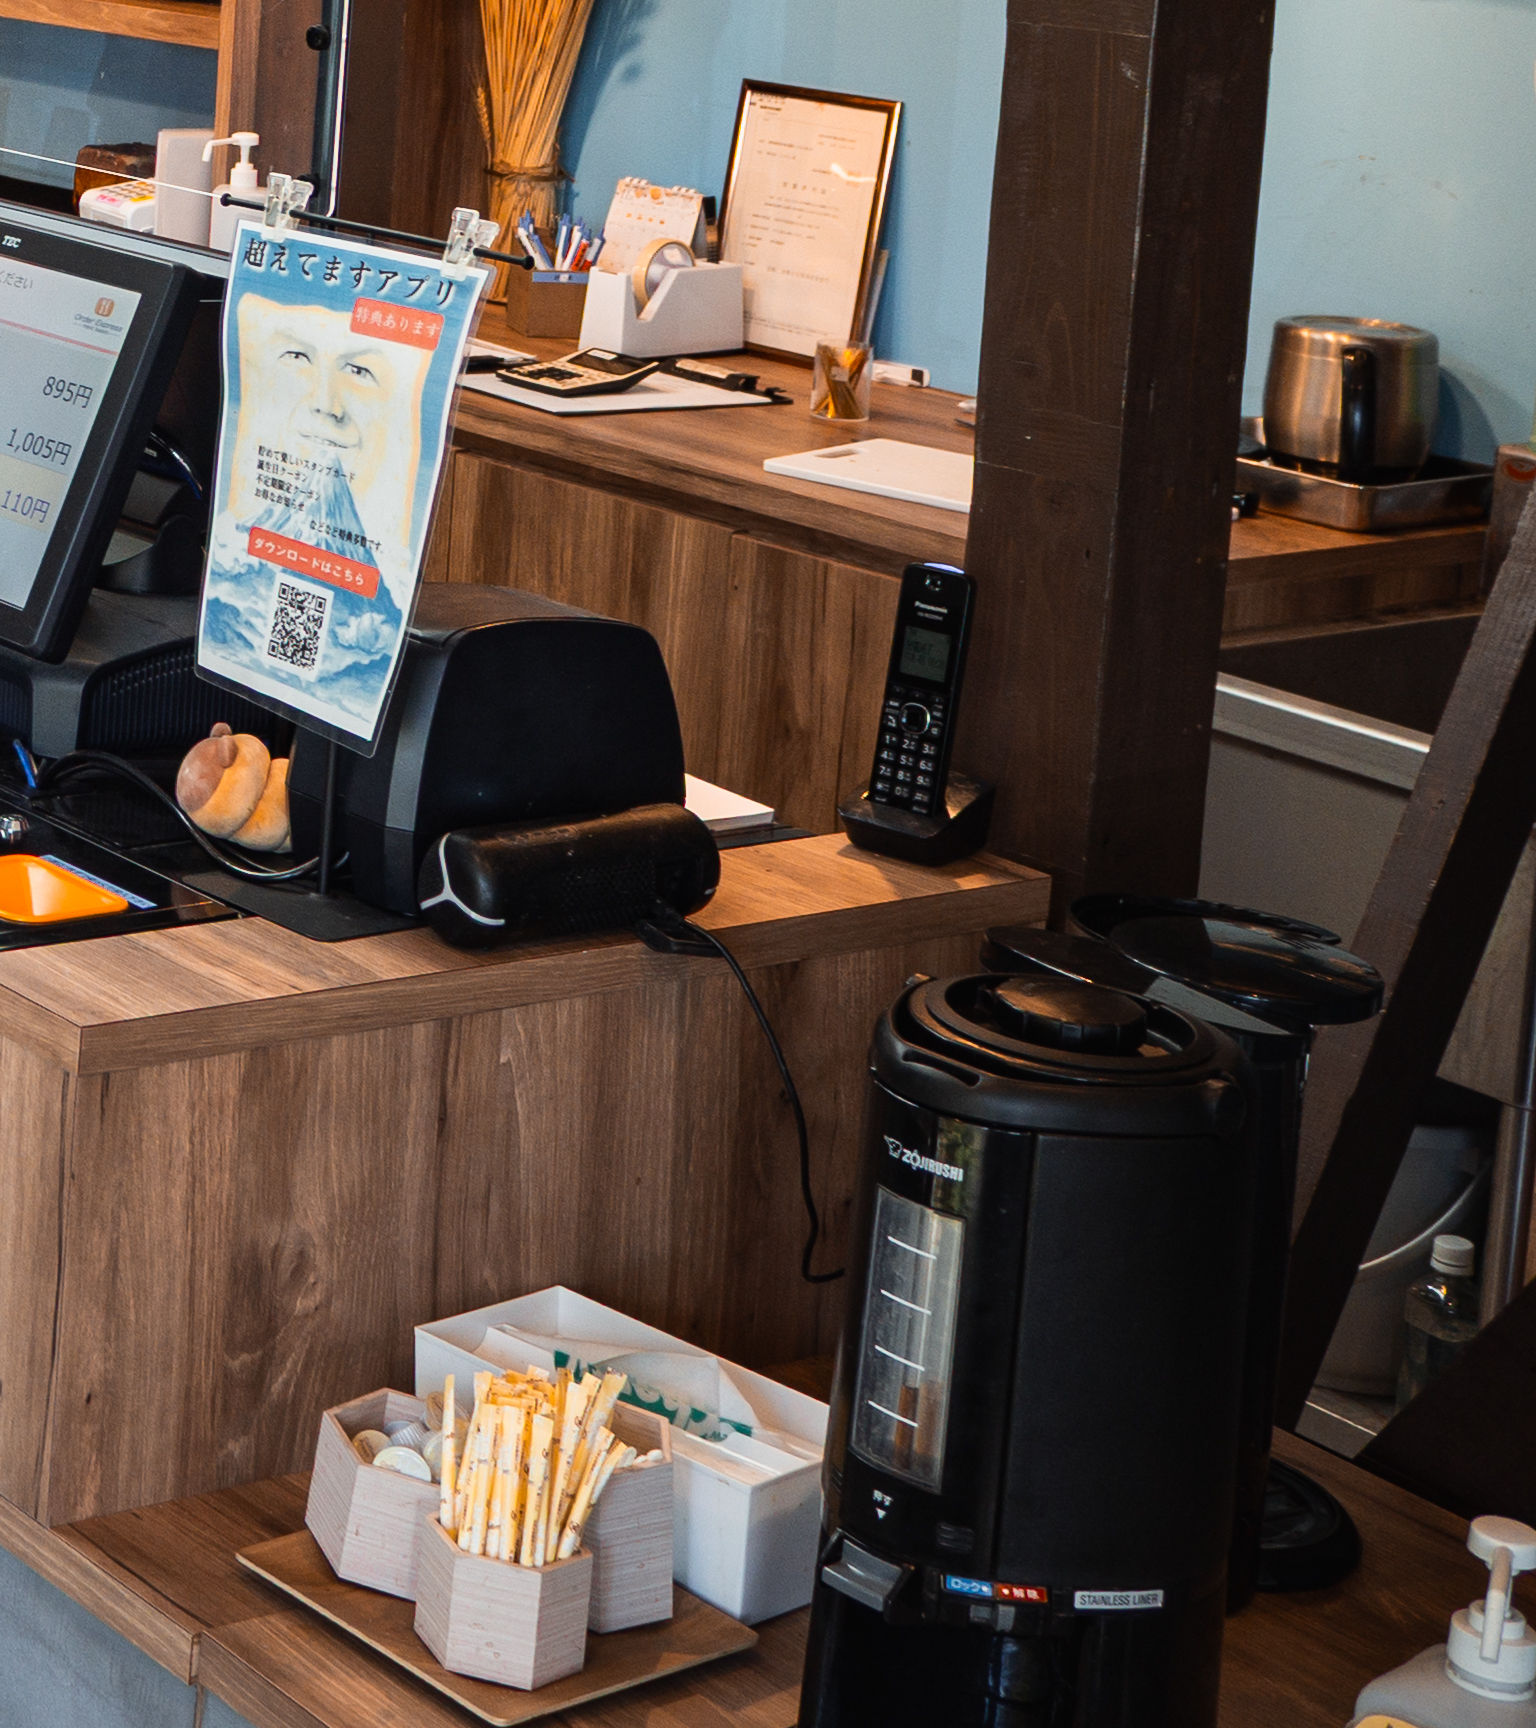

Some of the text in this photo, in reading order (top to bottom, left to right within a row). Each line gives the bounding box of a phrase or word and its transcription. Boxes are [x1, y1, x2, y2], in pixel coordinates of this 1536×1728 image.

[1, 235, 22, 249] TEC
[242, 237, 458, 308] 超えてますアプリ
[354, 306, 441, 340] 特典あります
[42, 375, 94, 409] 895円
[6, 427, 73, 466] 1,005円
[257, 444, 356, 483] 貯めて楽しいスタンプカード
[255, 473, 322, 502] 不定期限定クーポン
[256, 458, 309, 483] 誕生日クーポン
[0, 489, 51, 524] 110円
[254, 487, 305, 512] お得なお知らせ
[309, 519, 385, 555] などなど特典多数です。
[254, 537, 365, 586] ダウンロードはこちら
[950, 1577, 981, 1593] ロック
[1011, 1586, 1040, 1600] 解除
[1079, 1592, 1160, 1607] STAINLESS LINER
